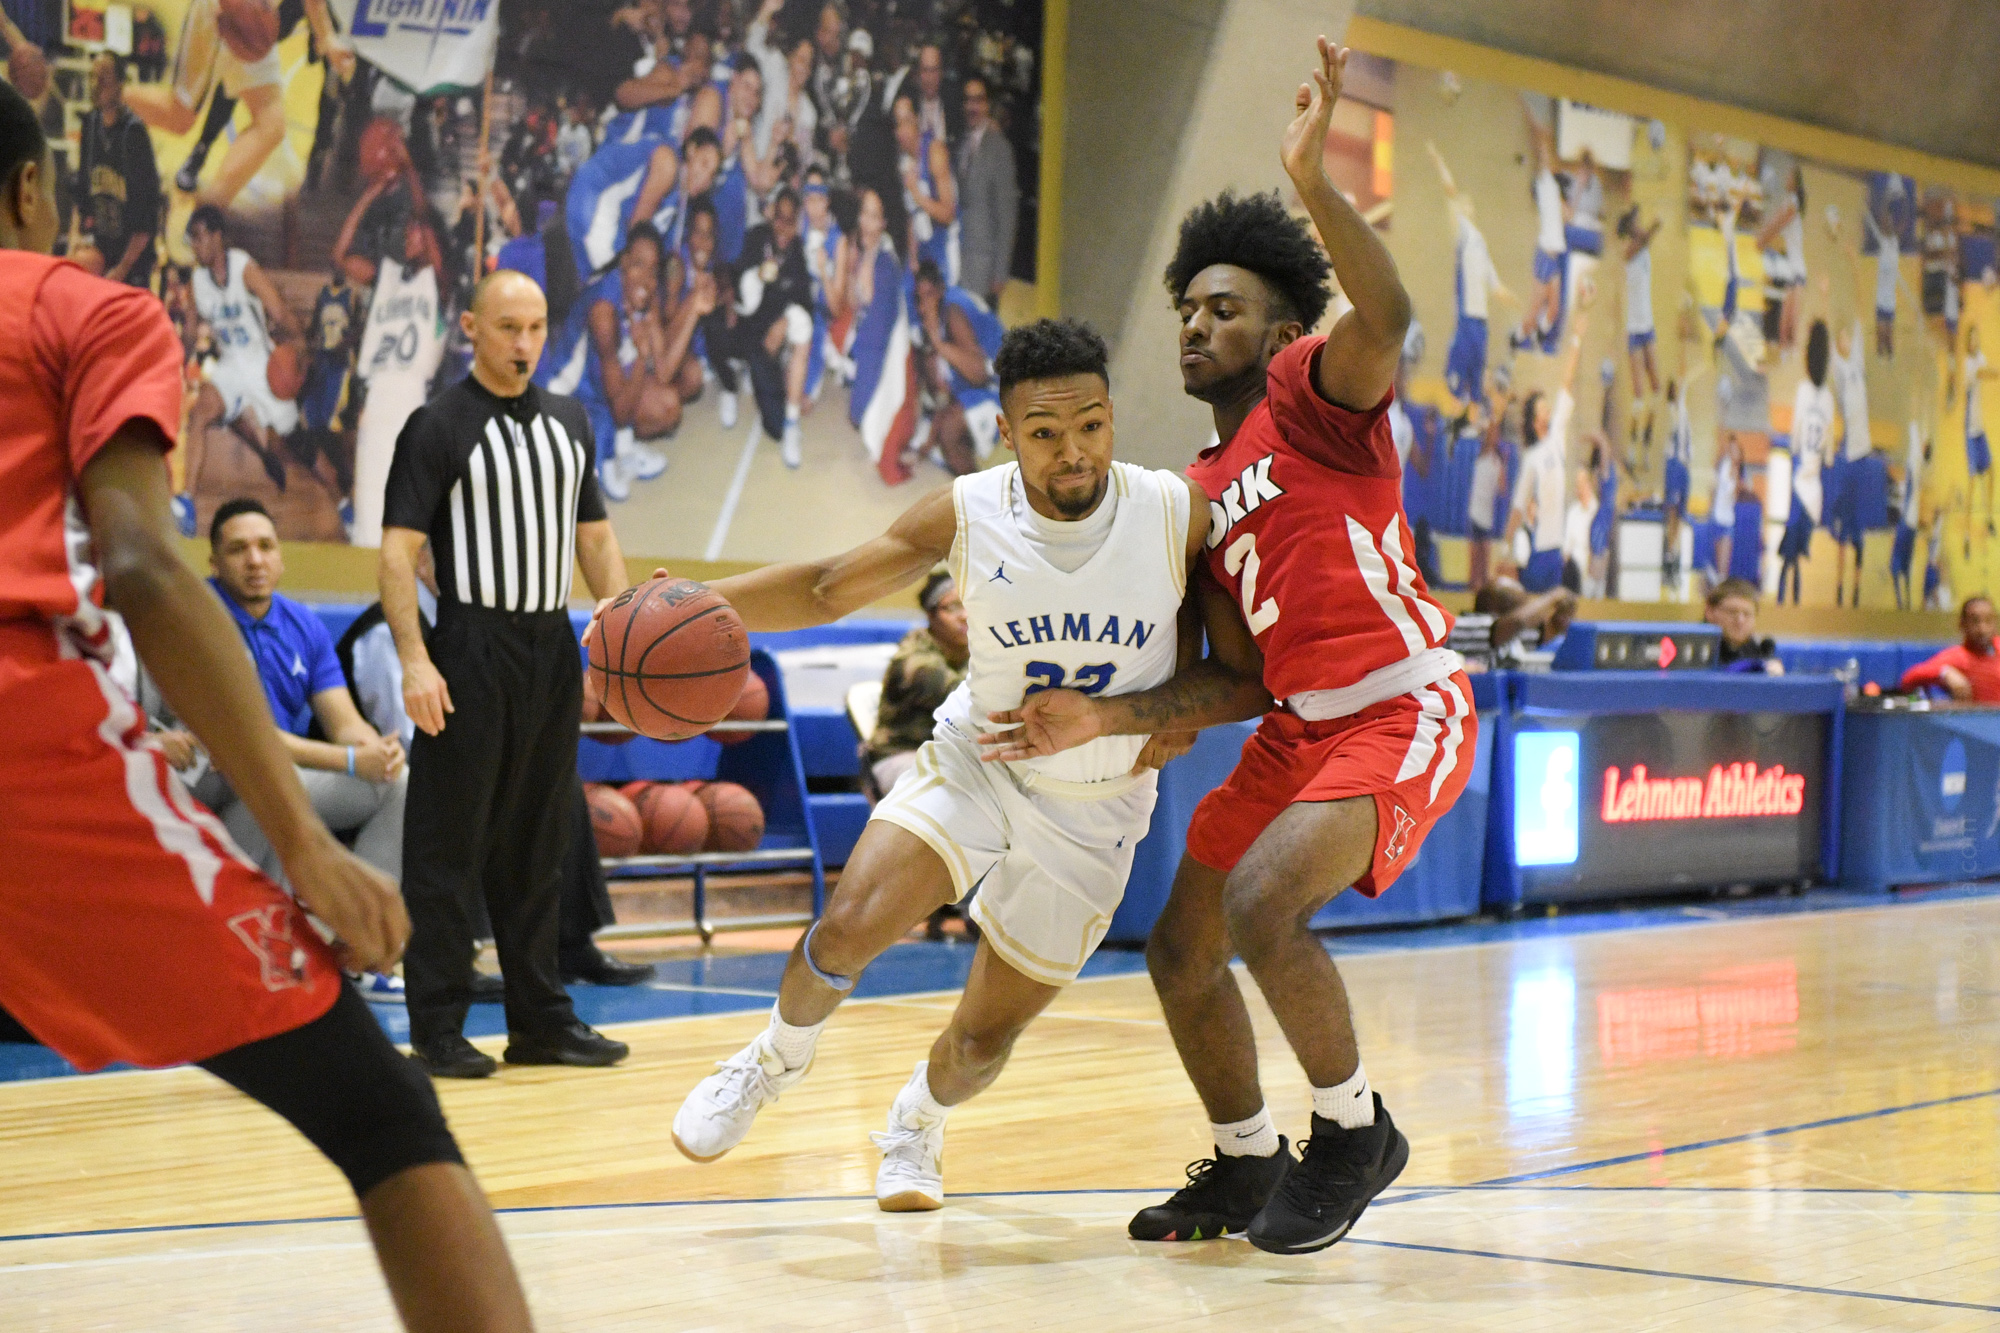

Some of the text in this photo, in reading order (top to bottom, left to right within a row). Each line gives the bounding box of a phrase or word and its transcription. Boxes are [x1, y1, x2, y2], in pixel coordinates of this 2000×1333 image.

[373, 322, 419, 365] 20
[1205, 453, 1287, 551] ORK
[1223, 532, 1281, 637] 2
[988, 612, 1156, 650] LEHMAN
[1602, 761, 1805, 823] Lehman Athletics
